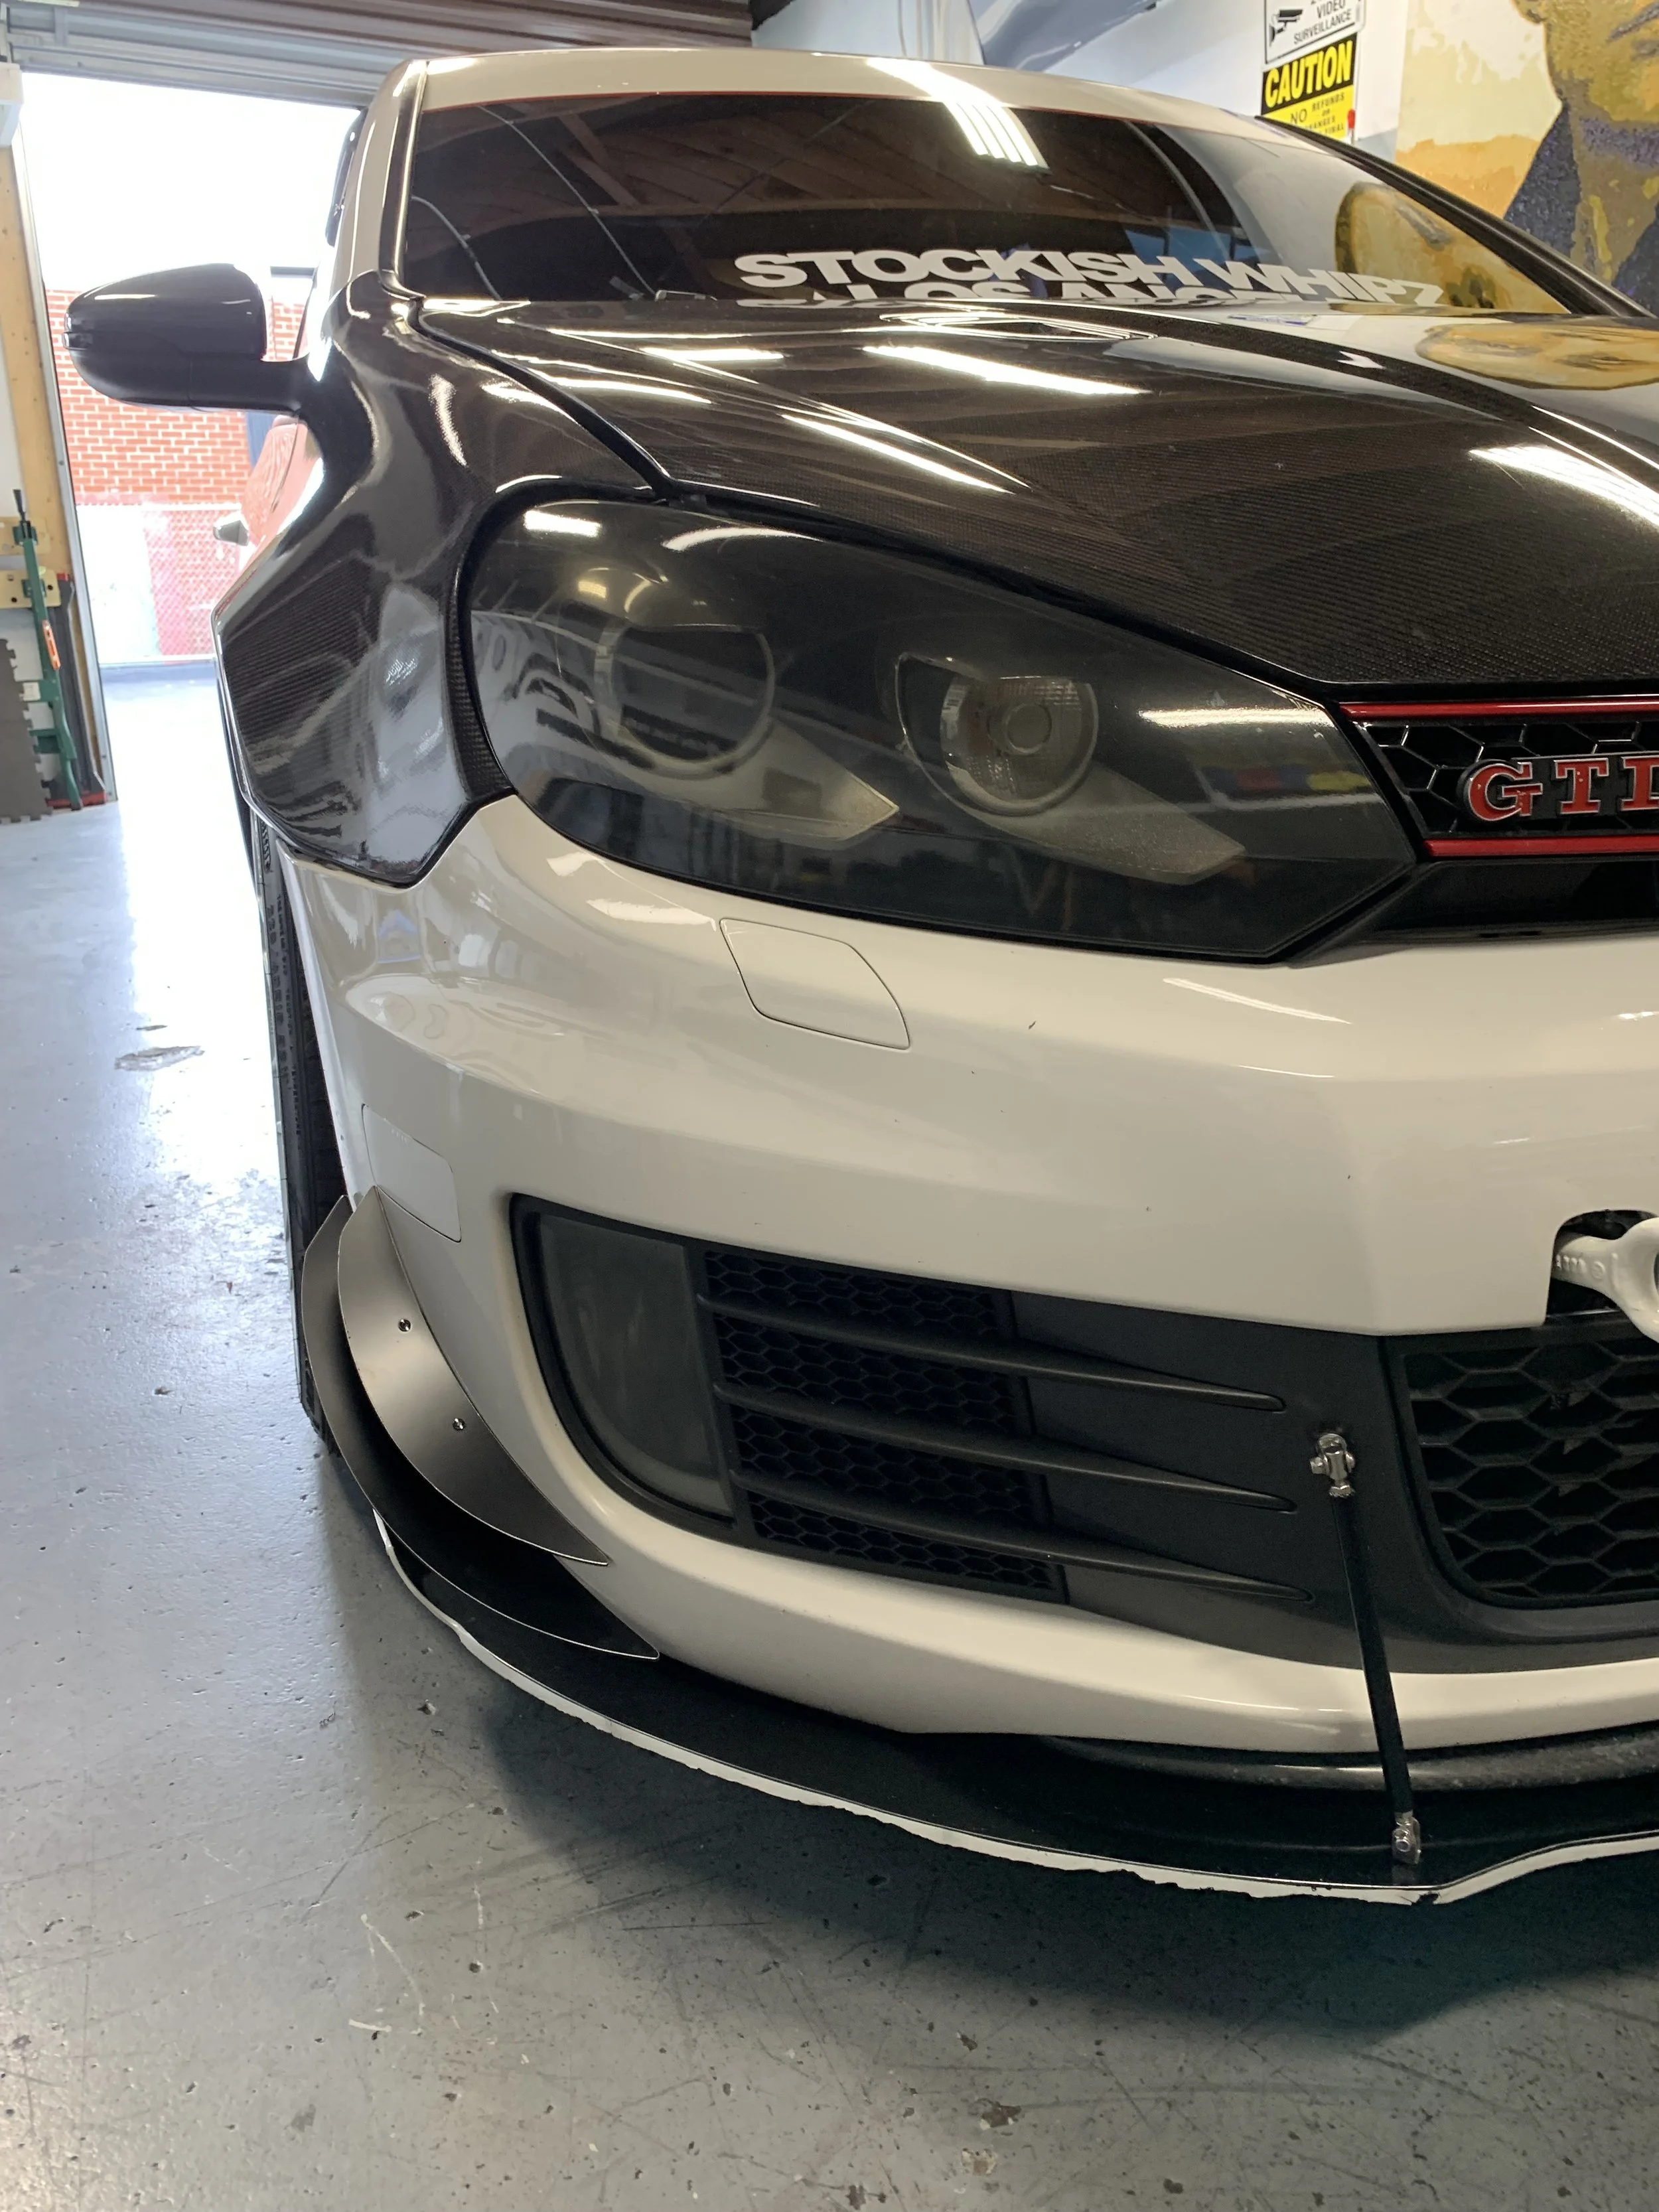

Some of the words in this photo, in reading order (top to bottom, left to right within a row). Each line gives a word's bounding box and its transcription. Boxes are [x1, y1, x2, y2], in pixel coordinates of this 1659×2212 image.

[1293, 9, 1352, 44] SURVEILLANCE
[1317, 0, 1345, 19] VIDEO
[1265, 40, 1353, 108] CAUTION
[1291, 108, 1307, 124] NO
[735, 249, 1204, 288] STOCKISH
[1468, 755, 1659, 822] GTI
